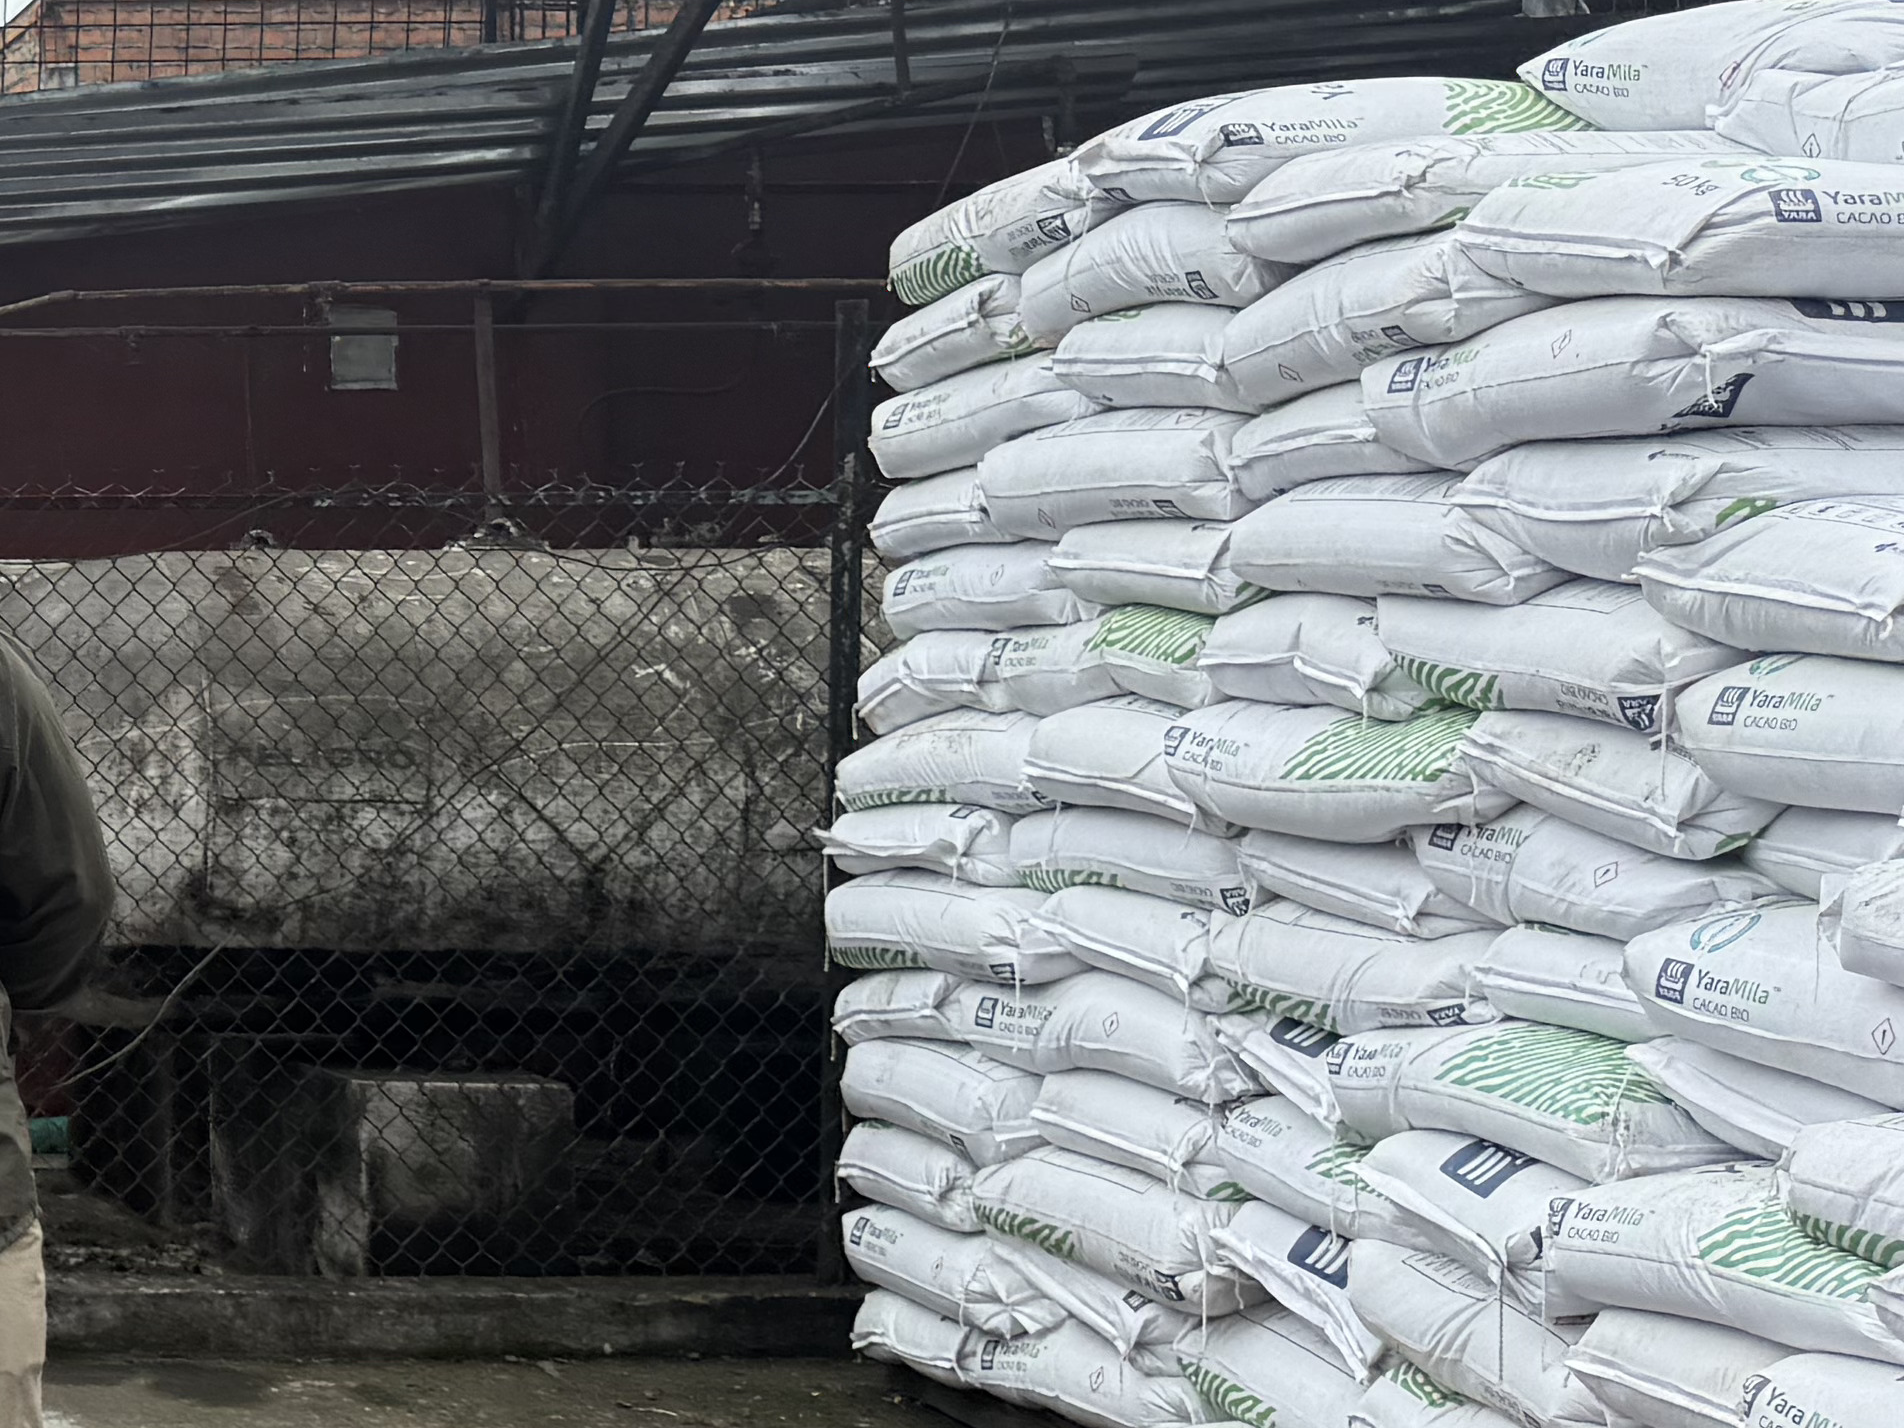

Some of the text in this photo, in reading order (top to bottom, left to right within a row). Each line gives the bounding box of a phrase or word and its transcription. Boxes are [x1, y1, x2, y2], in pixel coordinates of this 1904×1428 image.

[1748, 688, 1825, 714] YaraMila
[1694, 967, 1771, 1006] YaraMila
[1574, 1200, 1647, 1228] YaraMila
